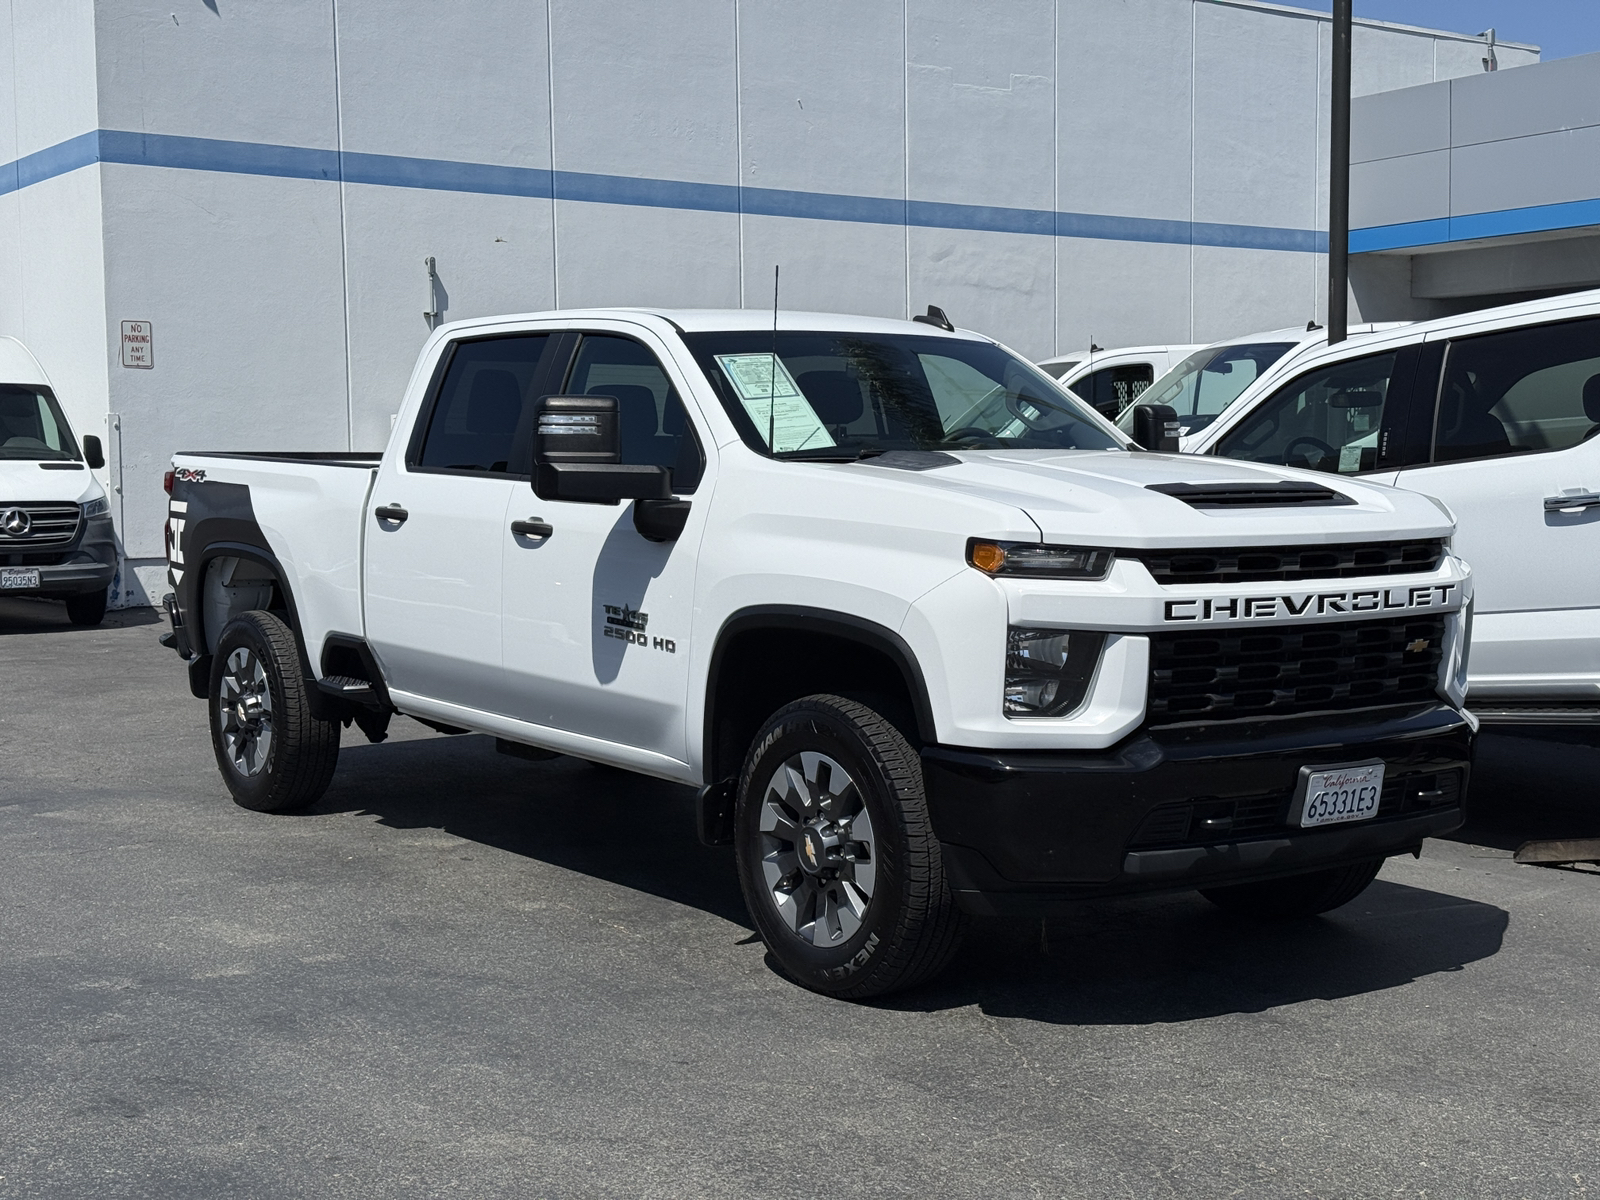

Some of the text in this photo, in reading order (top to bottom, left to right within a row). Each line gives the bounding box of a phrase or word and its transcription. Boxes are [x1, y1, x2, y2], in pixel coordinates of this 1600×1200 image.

[130, 324, 142, 333] NO
[124, 334, 150, 344] PARKING
[130, 354, 146, 363] TIME
[3, 575, 38, 588] 95035N3
[1164, 584, 1456, 621] CHEVROLET
[604, 625, 676, 654] 2500 HD
[1323, 774, 1370, 789] California
[1308, 786, 1377, 819] 65331E3
[822, 932, 881, 982] NEXEN
